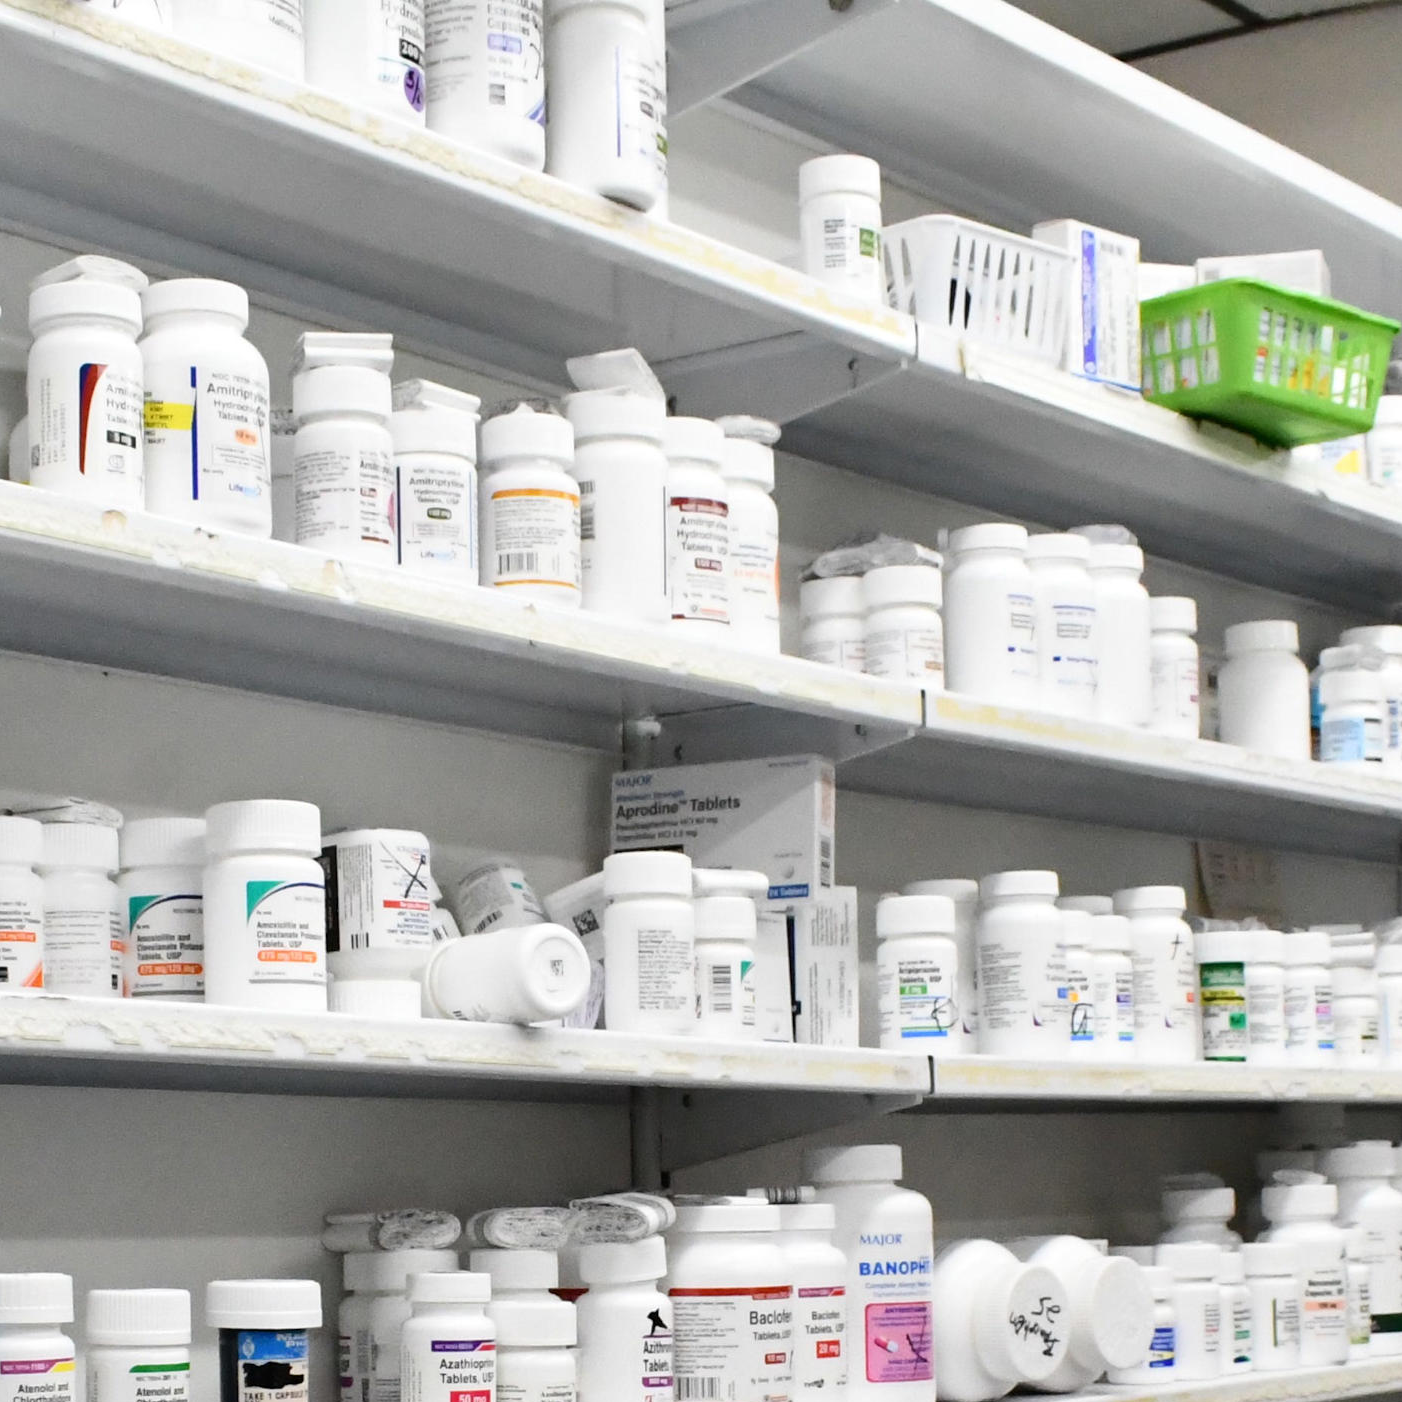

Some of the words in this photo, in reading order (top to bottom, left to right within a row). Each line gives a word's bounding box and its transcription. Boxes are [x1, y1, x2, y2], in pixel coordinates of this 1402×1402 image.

[690, 796, 741, 812] Tablets
[860, 1234, 902, 1246] MAJOR
[440, 1374, 479, 1384] Tablets,
[18, 1384, 55, 1393] Atenolol
[58, 1383, 68, 1391] and
[136, 1388, 171, 1396] Atenolol
